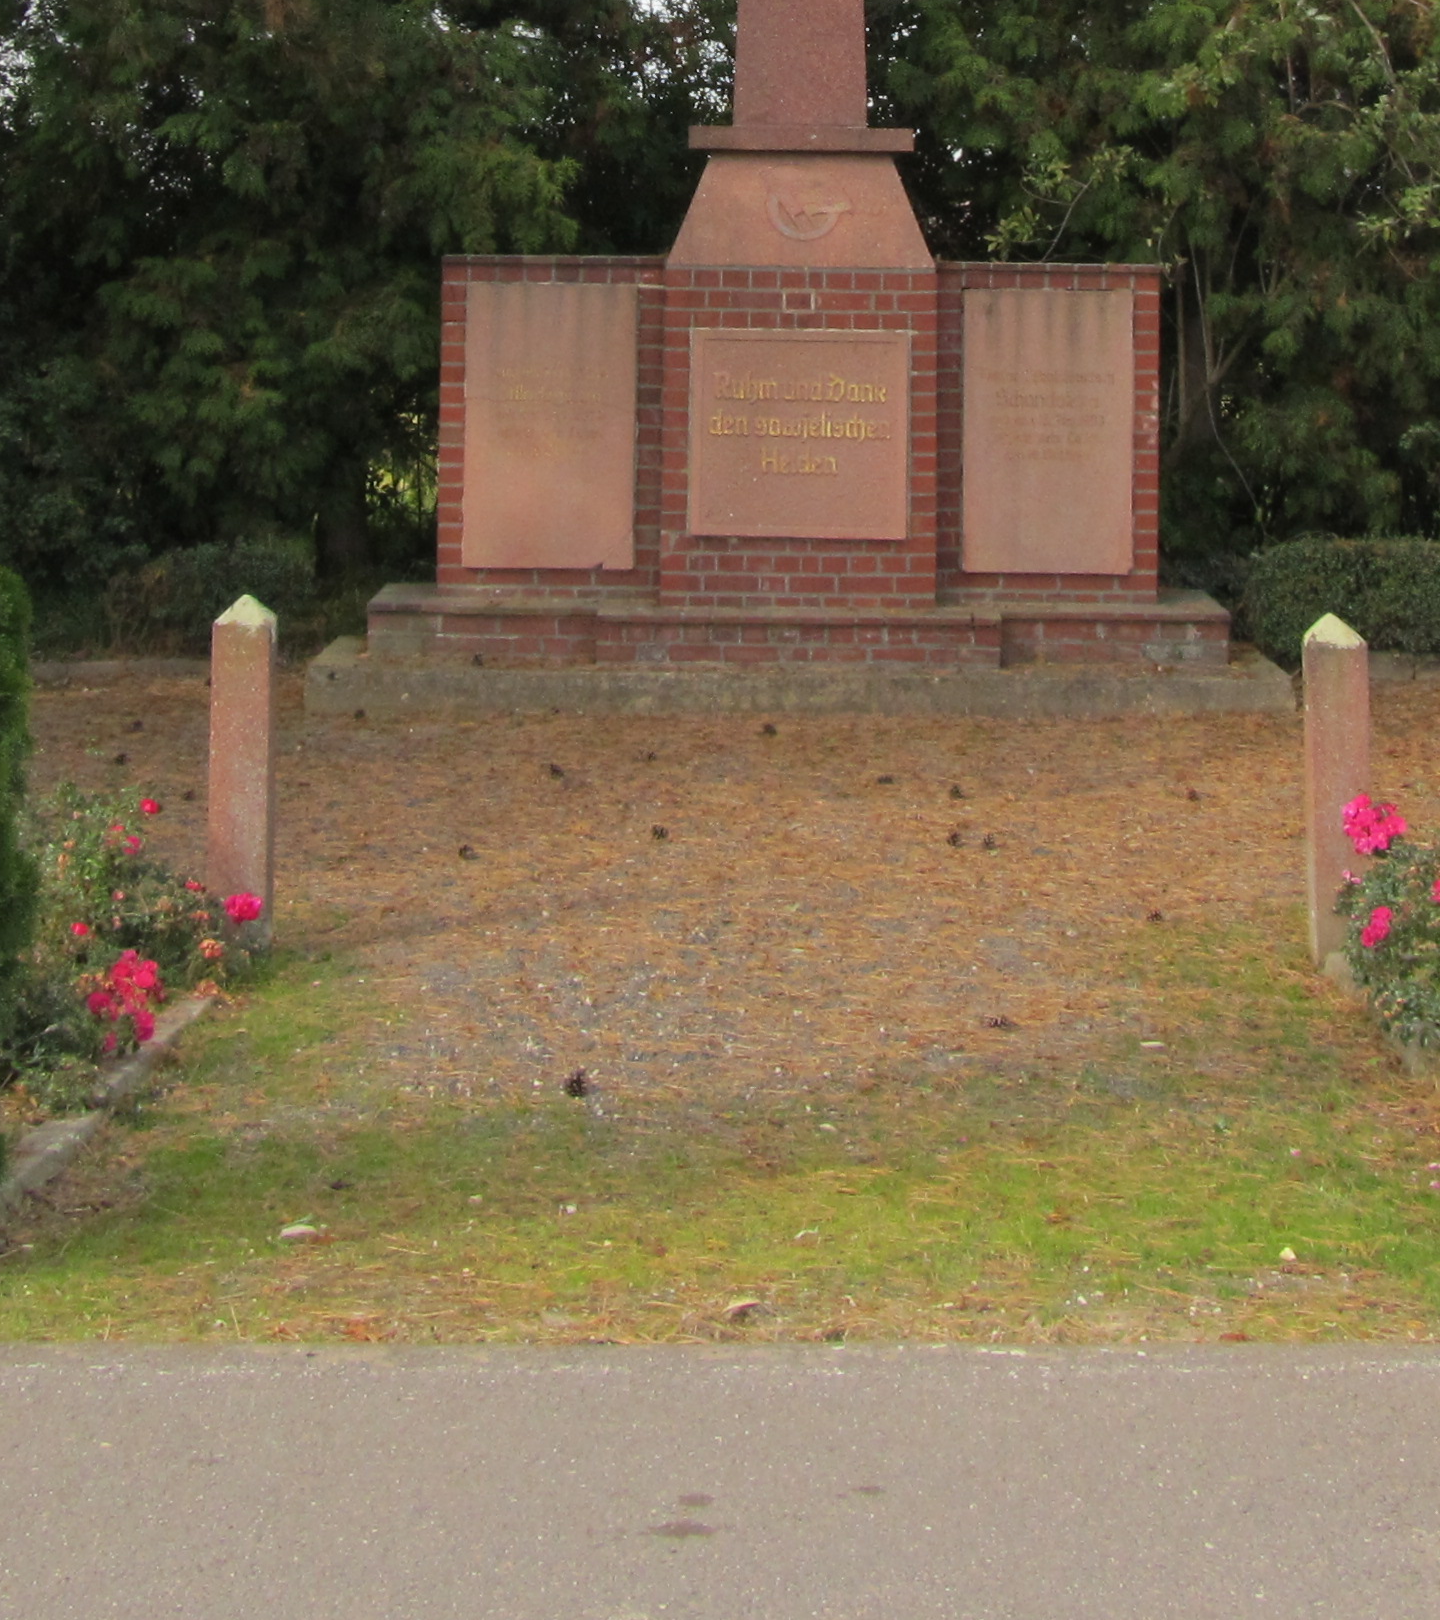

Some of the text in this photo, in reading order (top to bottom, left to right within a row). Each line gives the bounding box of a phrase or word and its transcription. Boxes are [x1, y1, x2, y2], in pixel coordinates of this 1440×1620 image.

[713, 371, 887, 404] Ruhm und Dank
[710, 409, 748, 437] den
